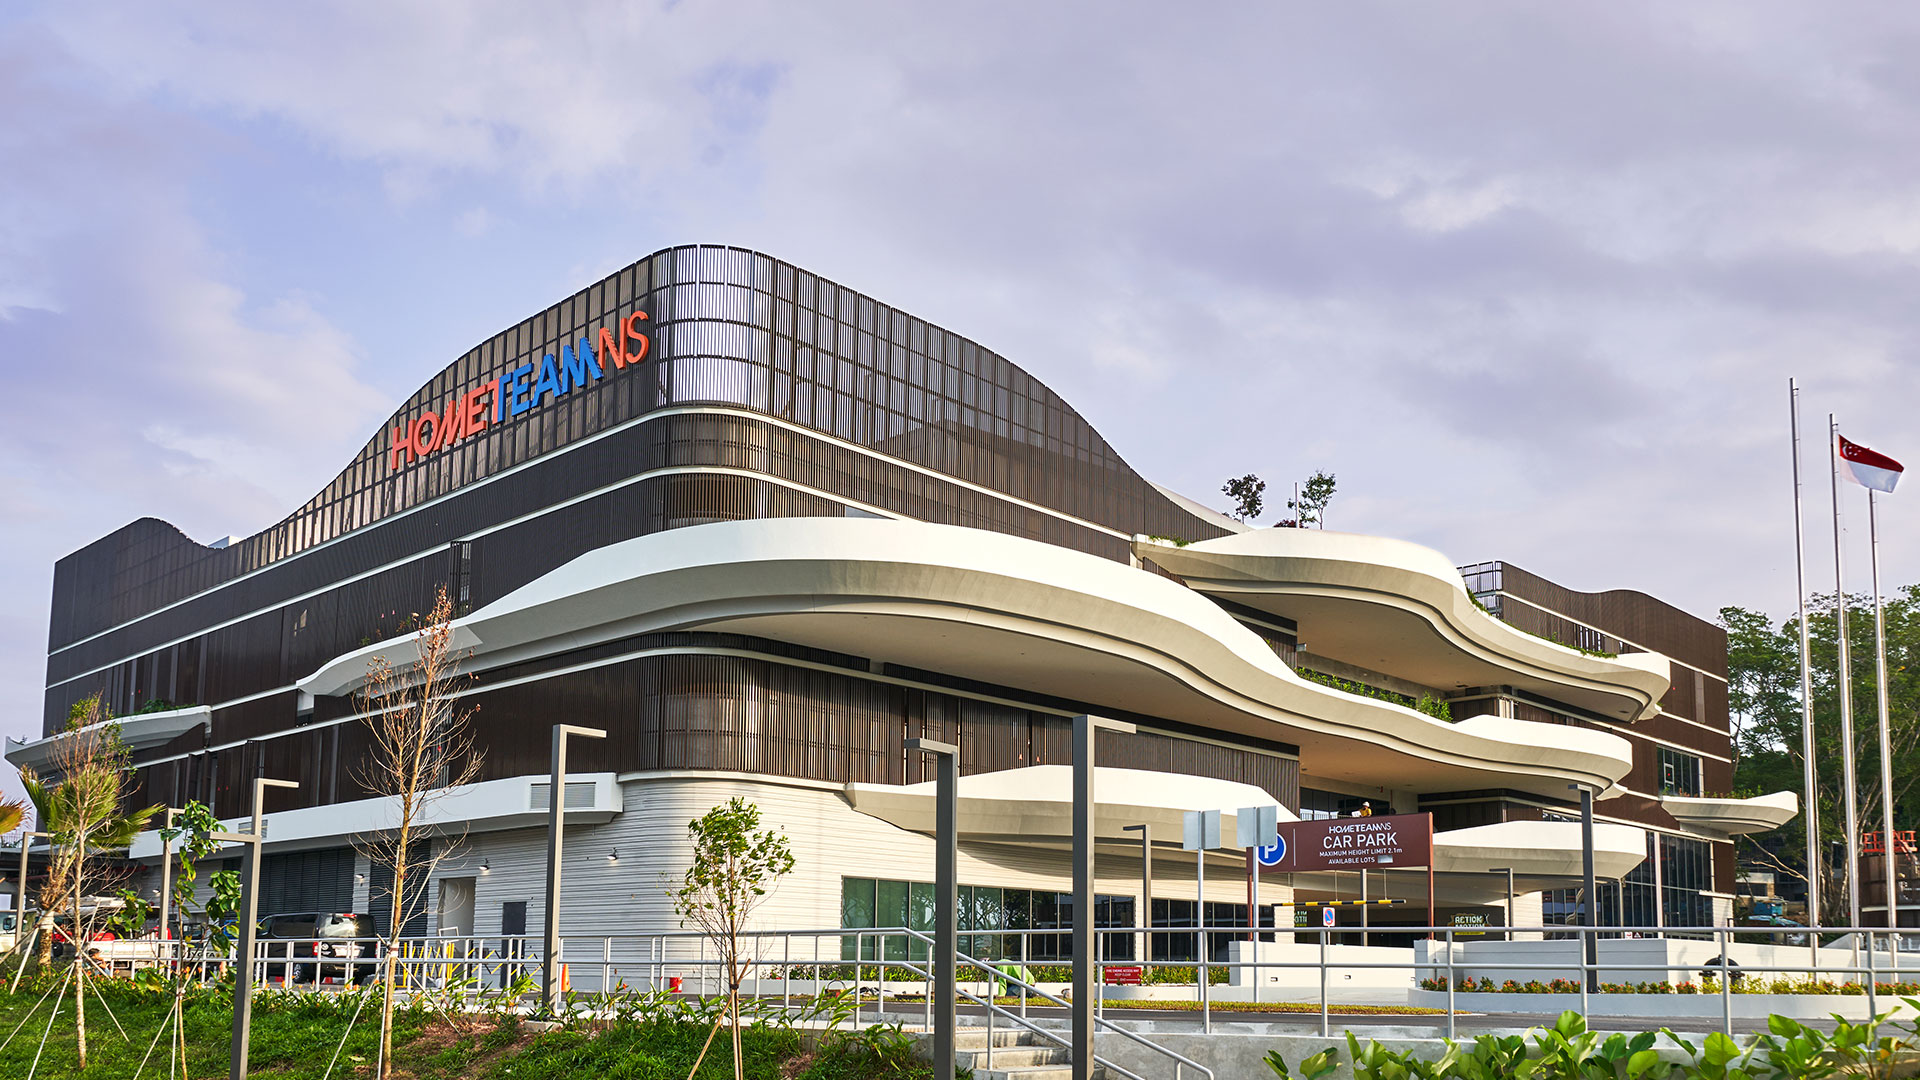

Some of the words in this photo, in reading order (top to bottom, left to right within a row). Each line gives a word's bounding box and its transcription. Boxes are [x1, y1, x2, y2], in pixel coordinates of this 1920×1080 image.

[391, 310, 650, 470] HOMETEAMNS
[1328, 822, 1392, 834] HOMETEAMNS
[1323, 834, 1353, 849] CAR
[1356, 831, 1398, 848] PARK
[1348, 848, 1370, 856] HEIGHT
[1328, 857, 1359, 865] AVAILABLE
[1454, 915, 1483, 924] ACTION
